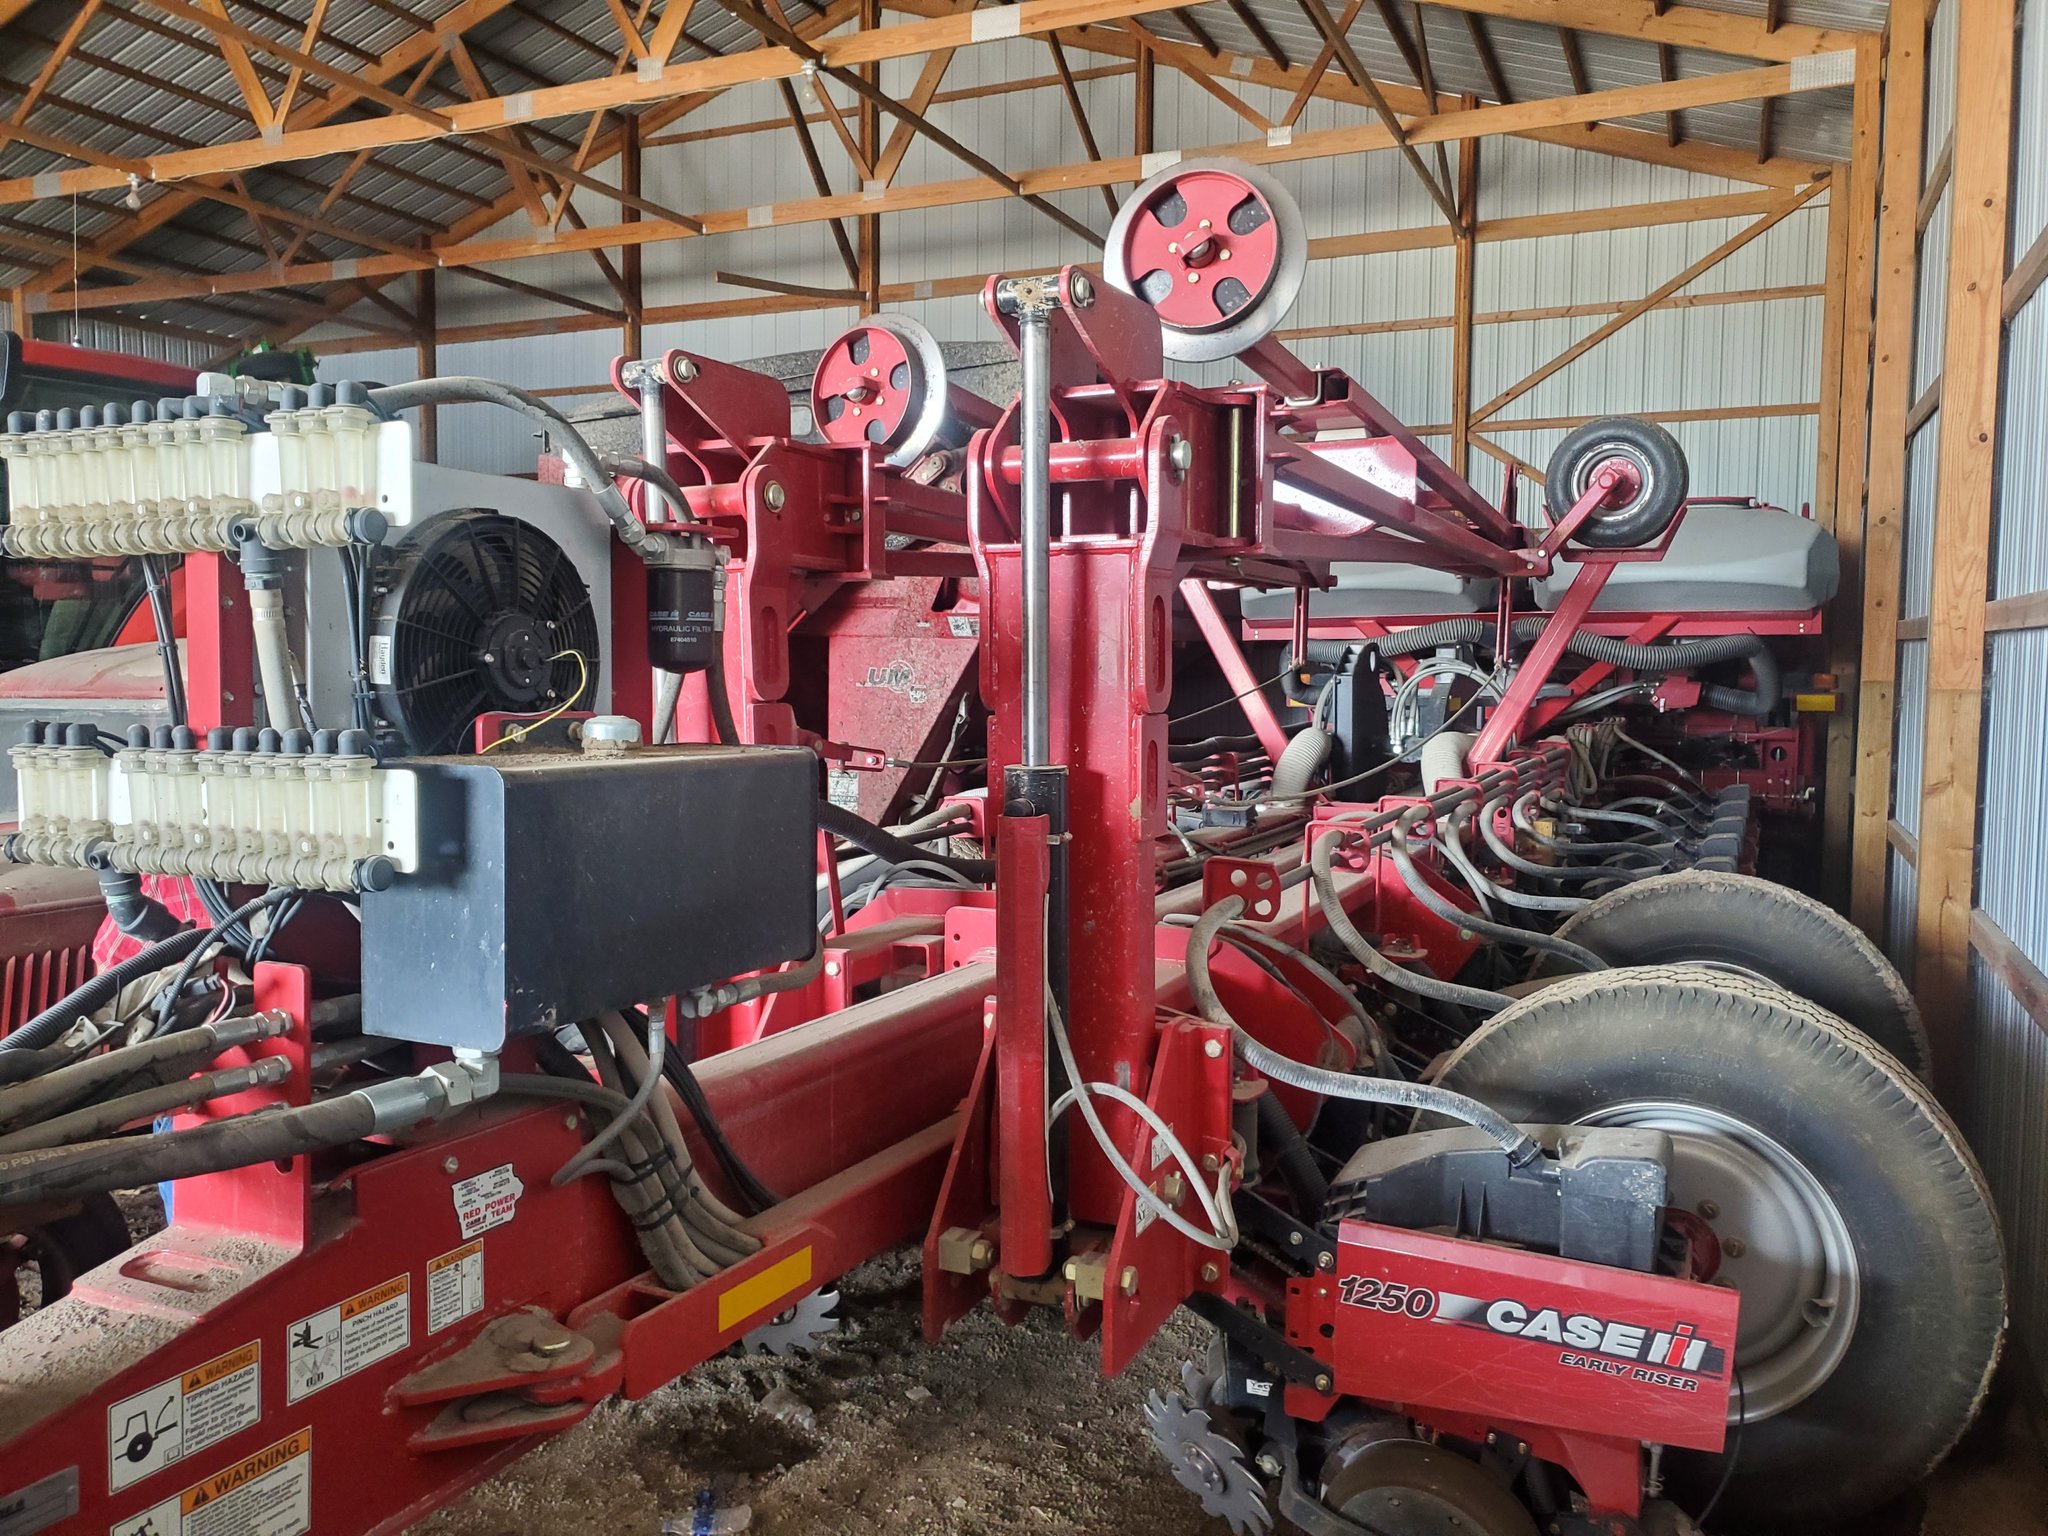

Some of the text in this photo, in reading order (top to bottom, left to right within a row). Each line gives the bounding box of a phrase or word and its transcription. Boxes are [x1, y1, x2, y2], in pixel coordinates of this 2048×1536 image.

[380, 642, 389, 675] Hayden
[11, 1154, 36, 1168] PSI
[37, 1148, 67, 1161] SAE
[463, 1192, 516, 1221] RED POWER
[491, 1203, 513, 1218] TEAM
[358, 1282, 403, 1308] WARNING
[352, 1302, 397, 1326] PINCH HAZARD
[1338, 1275, 1436, 1320] 1250
[1486, 1299, 1647, 1359] CASE
[205, 1350, 252, 1379] WARNING
[1559, 1353, 1699, 1393] EARLY RISER
[186, 1367, 254, 1404] TIPPING HAZARD
[215, 1439, 299, 1493] WARNING
